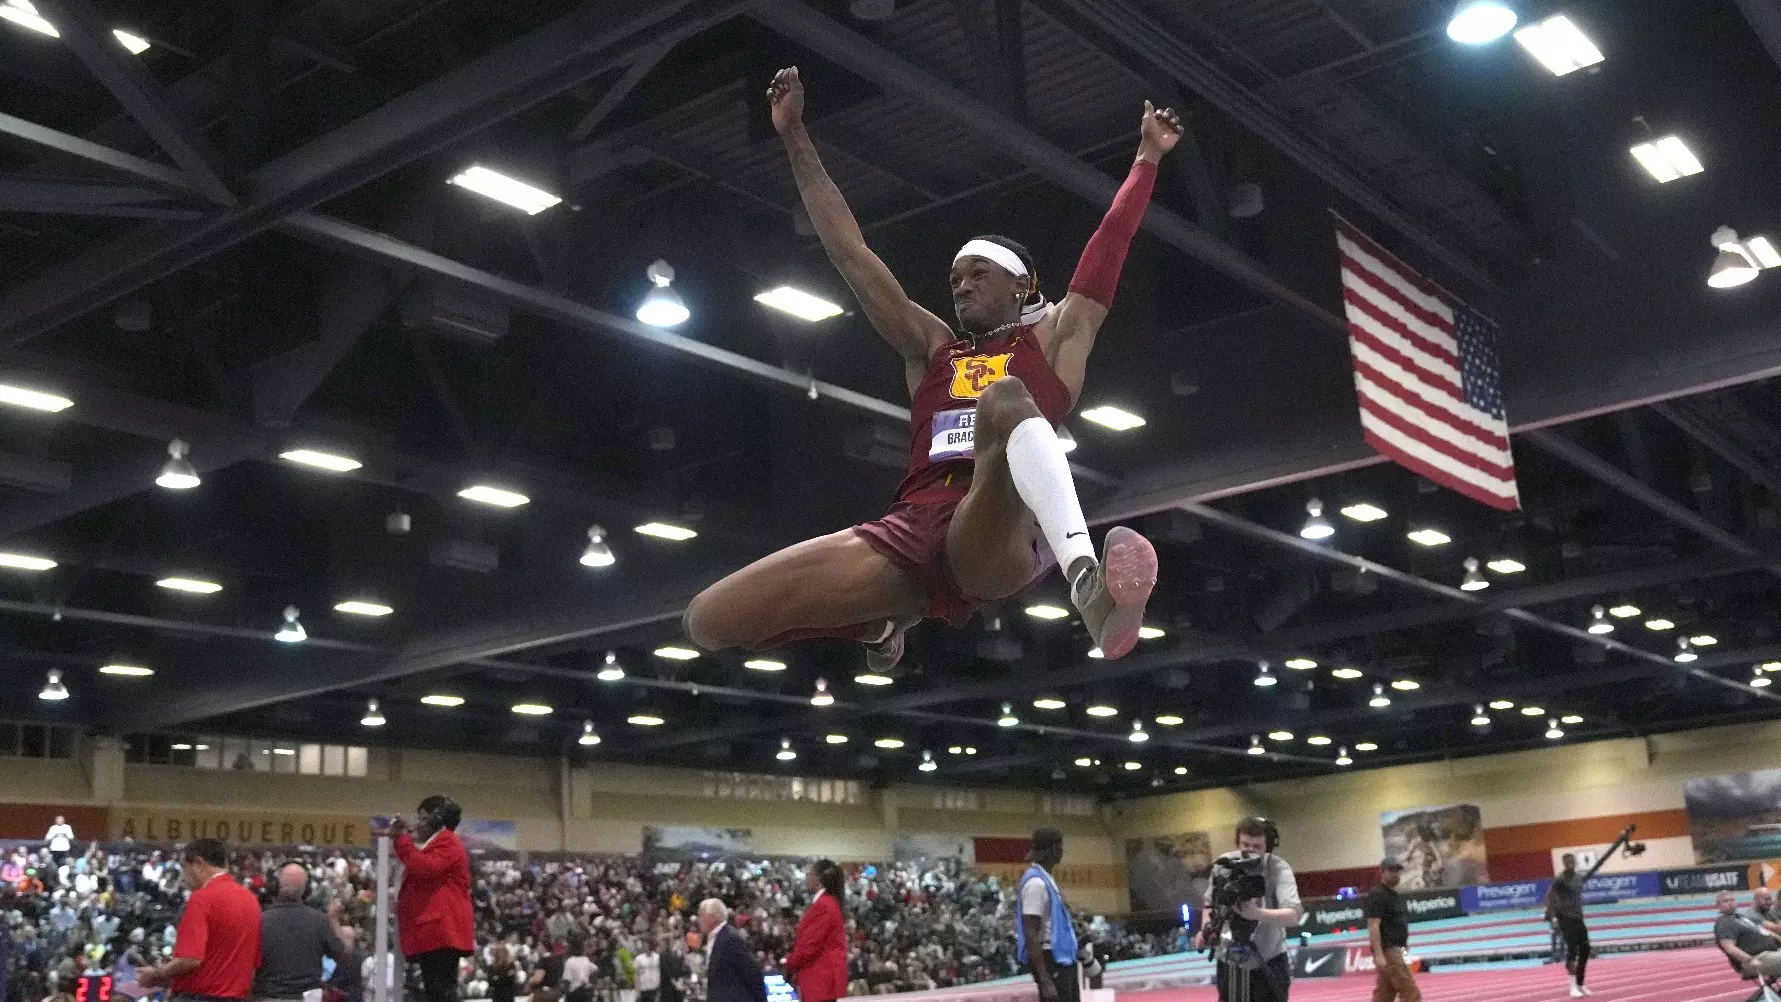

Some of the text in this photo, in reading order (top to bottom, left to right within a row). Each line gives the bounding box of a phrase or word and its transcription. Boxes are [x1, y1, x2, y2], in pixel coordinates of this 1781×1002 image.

[121, 816, 356, 845] ALBUQUERQUE
[1406, 896, 1457, 914] Hyperice
[1316, 908, 1365, 926] Hyperice
